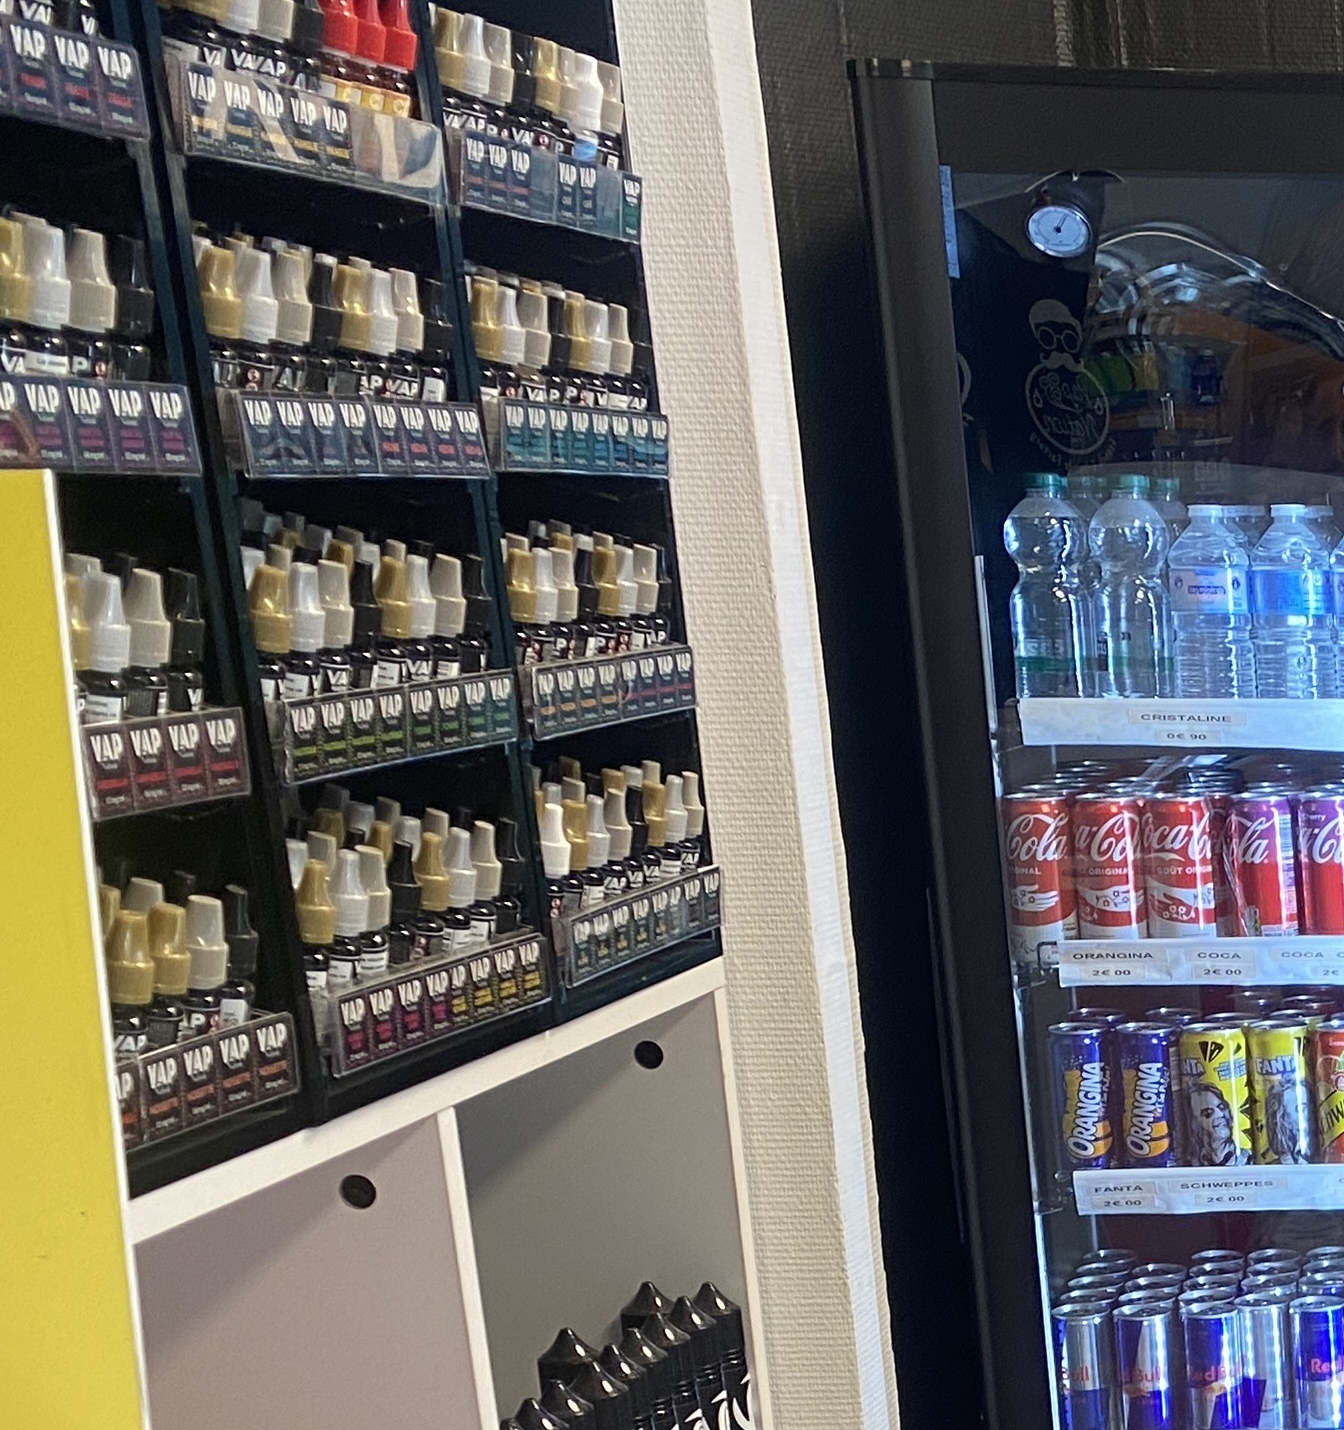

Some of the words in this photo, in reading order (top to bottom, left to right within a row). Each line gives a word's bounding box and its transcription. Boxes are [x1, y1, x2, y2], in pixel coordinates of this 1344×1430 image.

[10, 24, 45, 60] VAP
[97, 46, 132, 80] VAP
[224, 81, 251, 111] VAP
[512, 149, 530, 173] VAP
[67, 386, 101, 418] VAP
[150, 391, 184, 422] VAP
[428, 409, 452, 432] VAP
[321, 701, 346, 730] VAP
[1140, 713, 1232, 723] CRISTALINE
[90, 732, 125, 764] VAP
[130, 728, 163, 758] VAP
[1072, 951, 1154, 960] ORANGINA
[1196, 951, 1243, 960] COCA
[257, 1022, 288, 1055] VAP
[183, 1045, 214, 1080] VAP
[1180, 1180, 1273, 1190] SCHWEPPES
